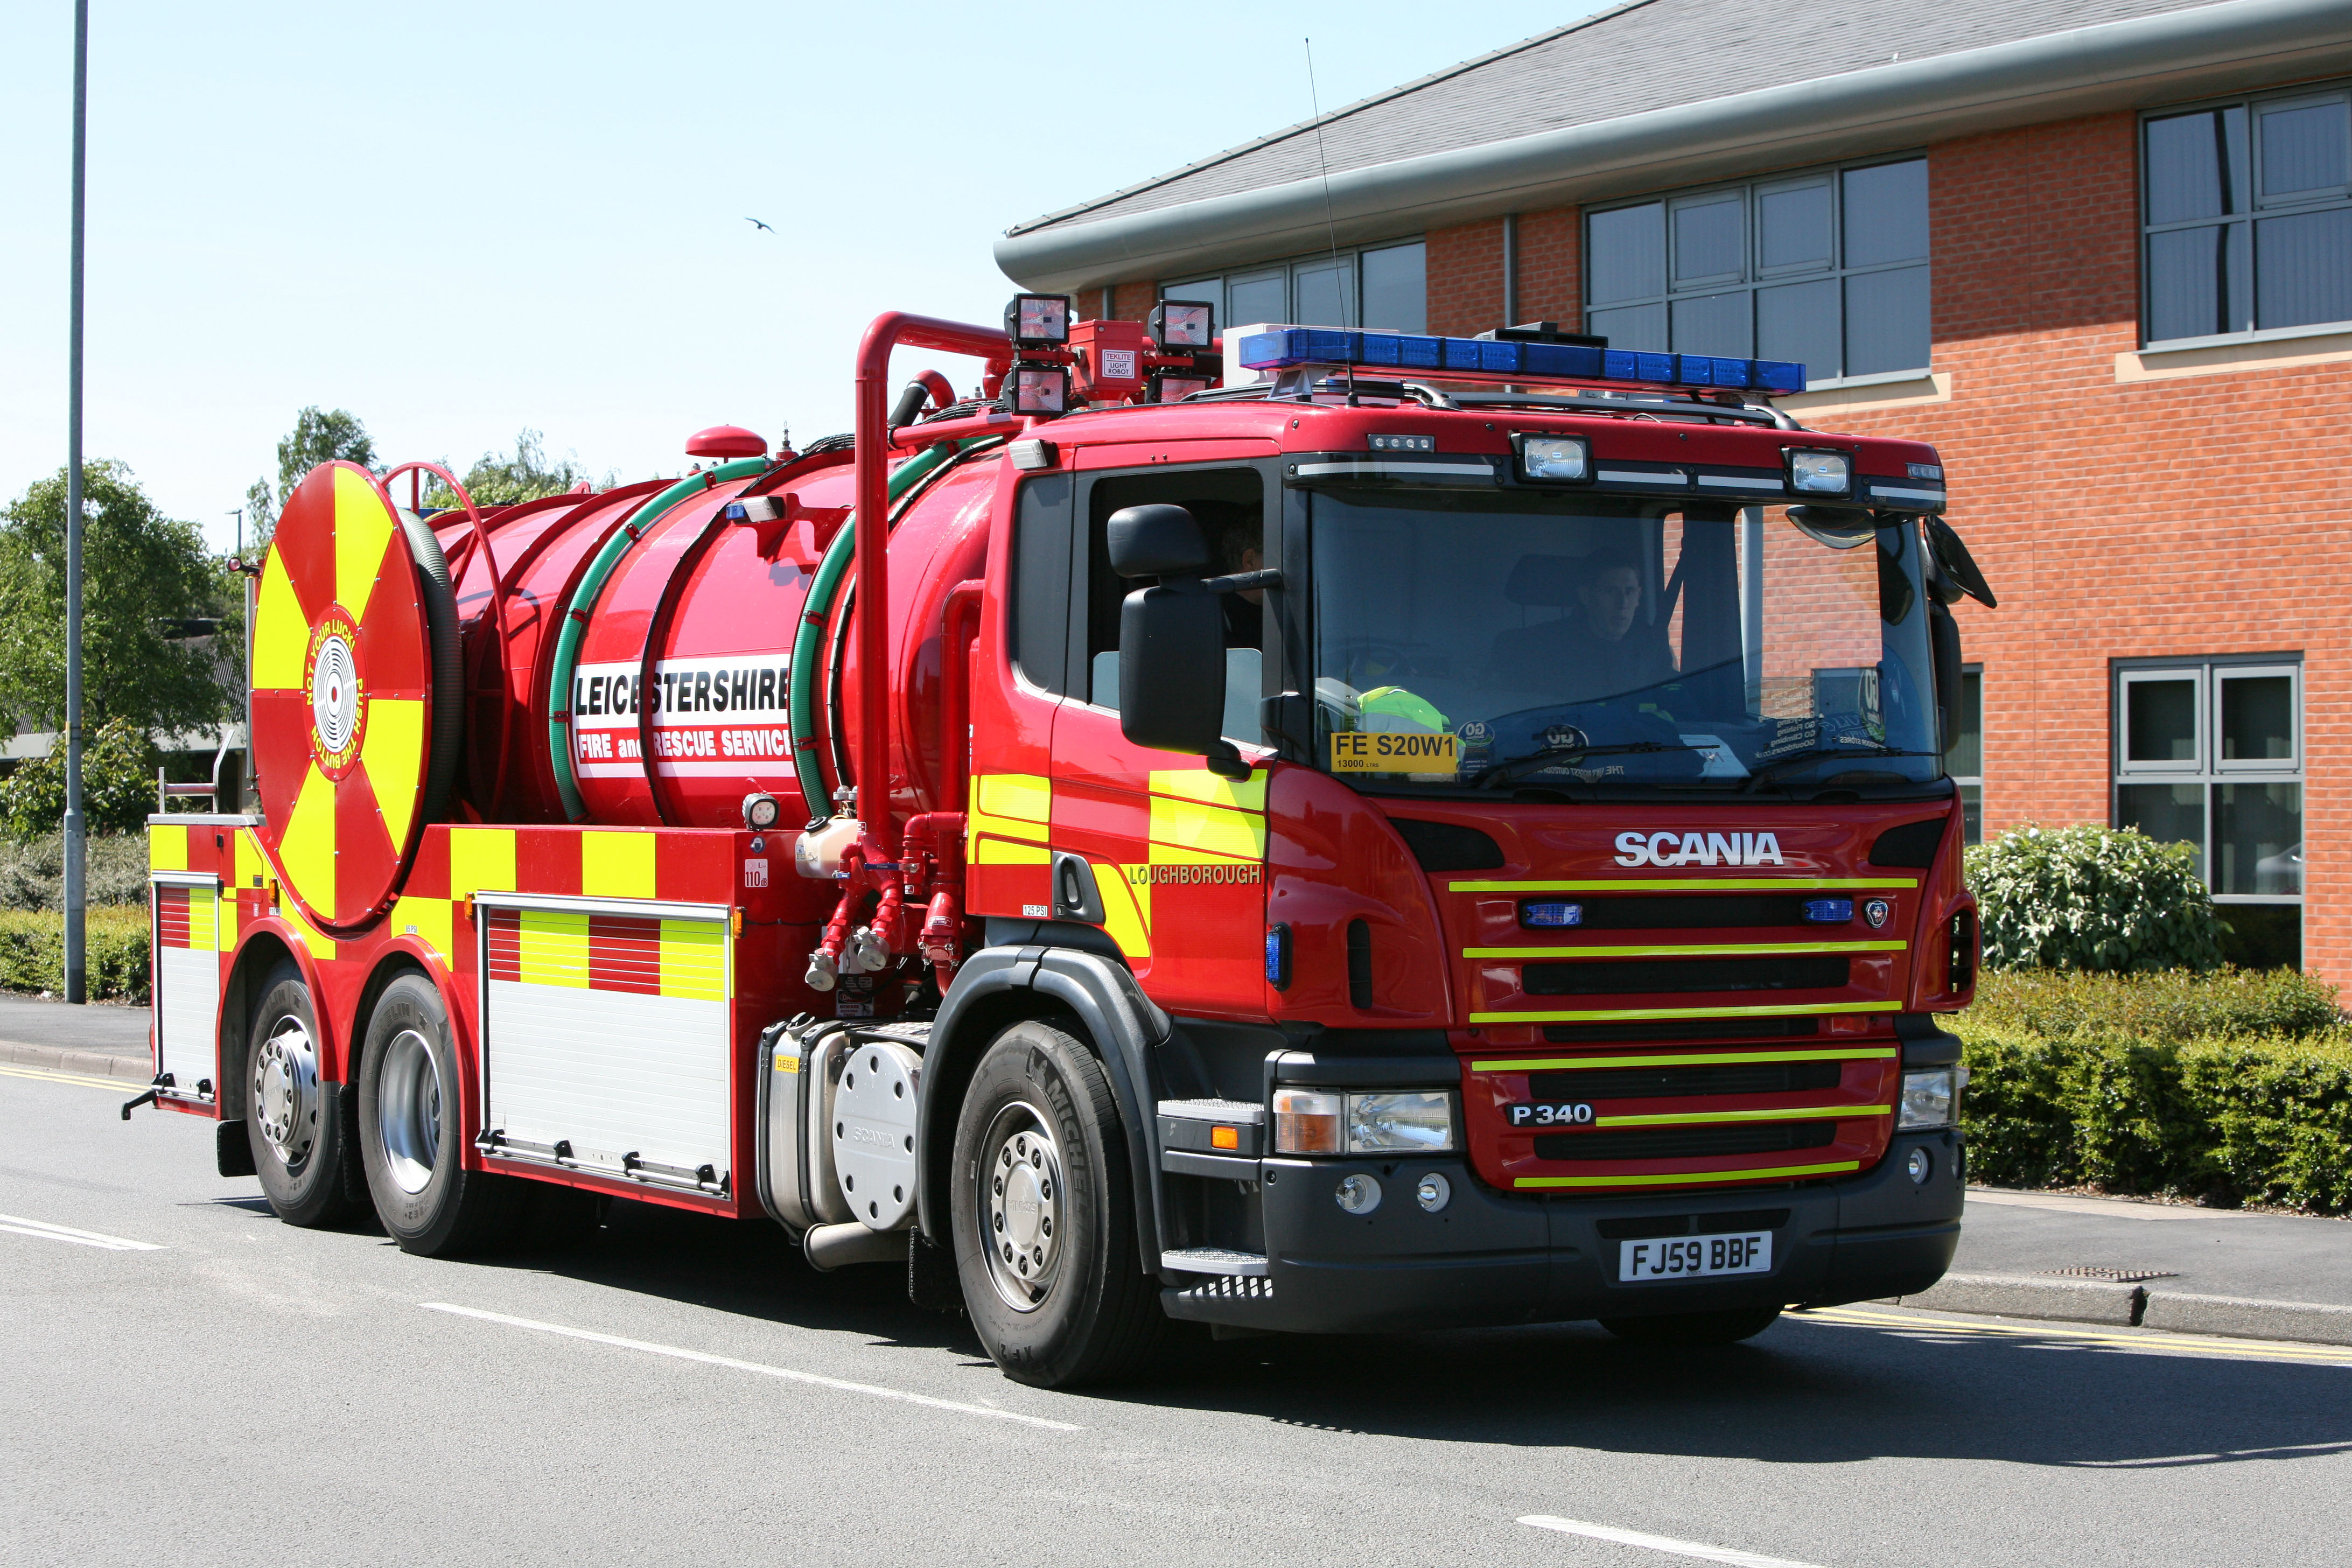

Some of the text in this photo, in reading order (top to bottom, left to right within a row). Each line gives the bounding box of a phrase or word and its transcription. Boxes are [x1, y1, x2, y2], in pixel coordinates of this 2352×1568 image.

[311, 621, 331, 659] YOUR
[332, 619, 356, 653] LUCK!
[311, 678, 363, 769] PUSH THE BUTTON
[579, 733, 612, 758] FIRE
[654, 730, 717, 757] RESCUE
[1336, 735, 1452, 757] FE S20W1
[1613, 831, 1784, 867] SCANIA
[745, 871, 760, 886] 110
[1129, 865, 1261, 884] LOUGHBOROUGH
[1025, 906, 1046, 915] 125 PSI
[778, 1059, 796, 1070] DIESEL
[1514, 1104, 1592, 1124] P 340
[853, 1126, 895, 1149] SCANIA
[1633, 1237, 1761, 1276] FJ59 BBF
